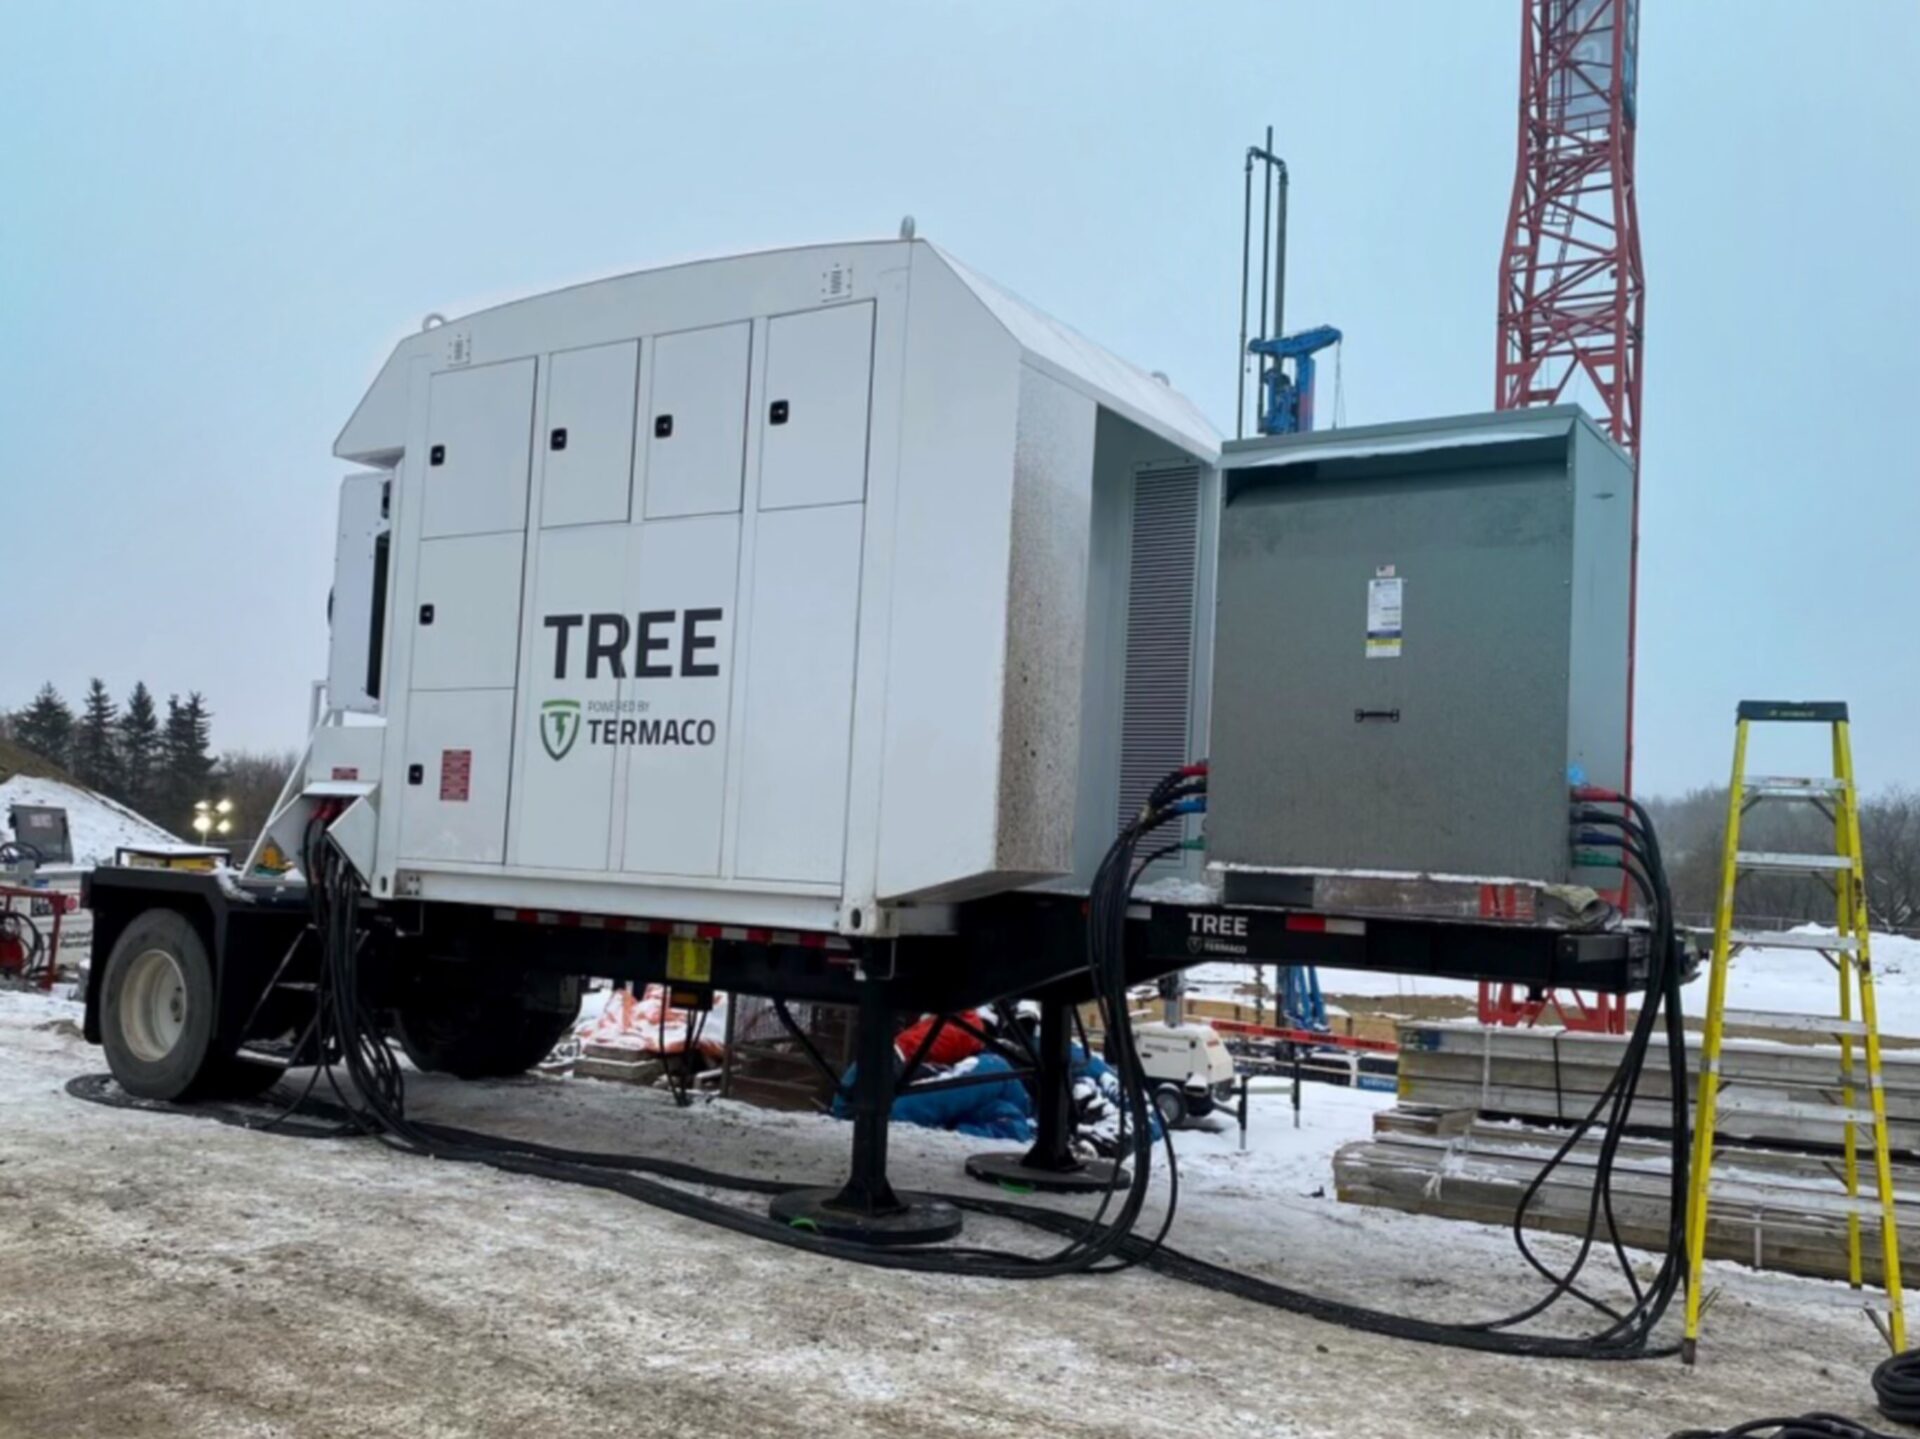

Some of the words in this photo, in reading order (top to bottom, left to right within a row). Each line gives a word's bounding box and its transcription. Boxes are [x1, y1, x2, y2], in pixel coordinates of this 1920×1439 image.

[544, 607, 723, 679] TREE
[637, 700, 650, 712] BY
[587, 719, 716, 745] TERMACO
[1187, 912, 1249, 937] TREE
